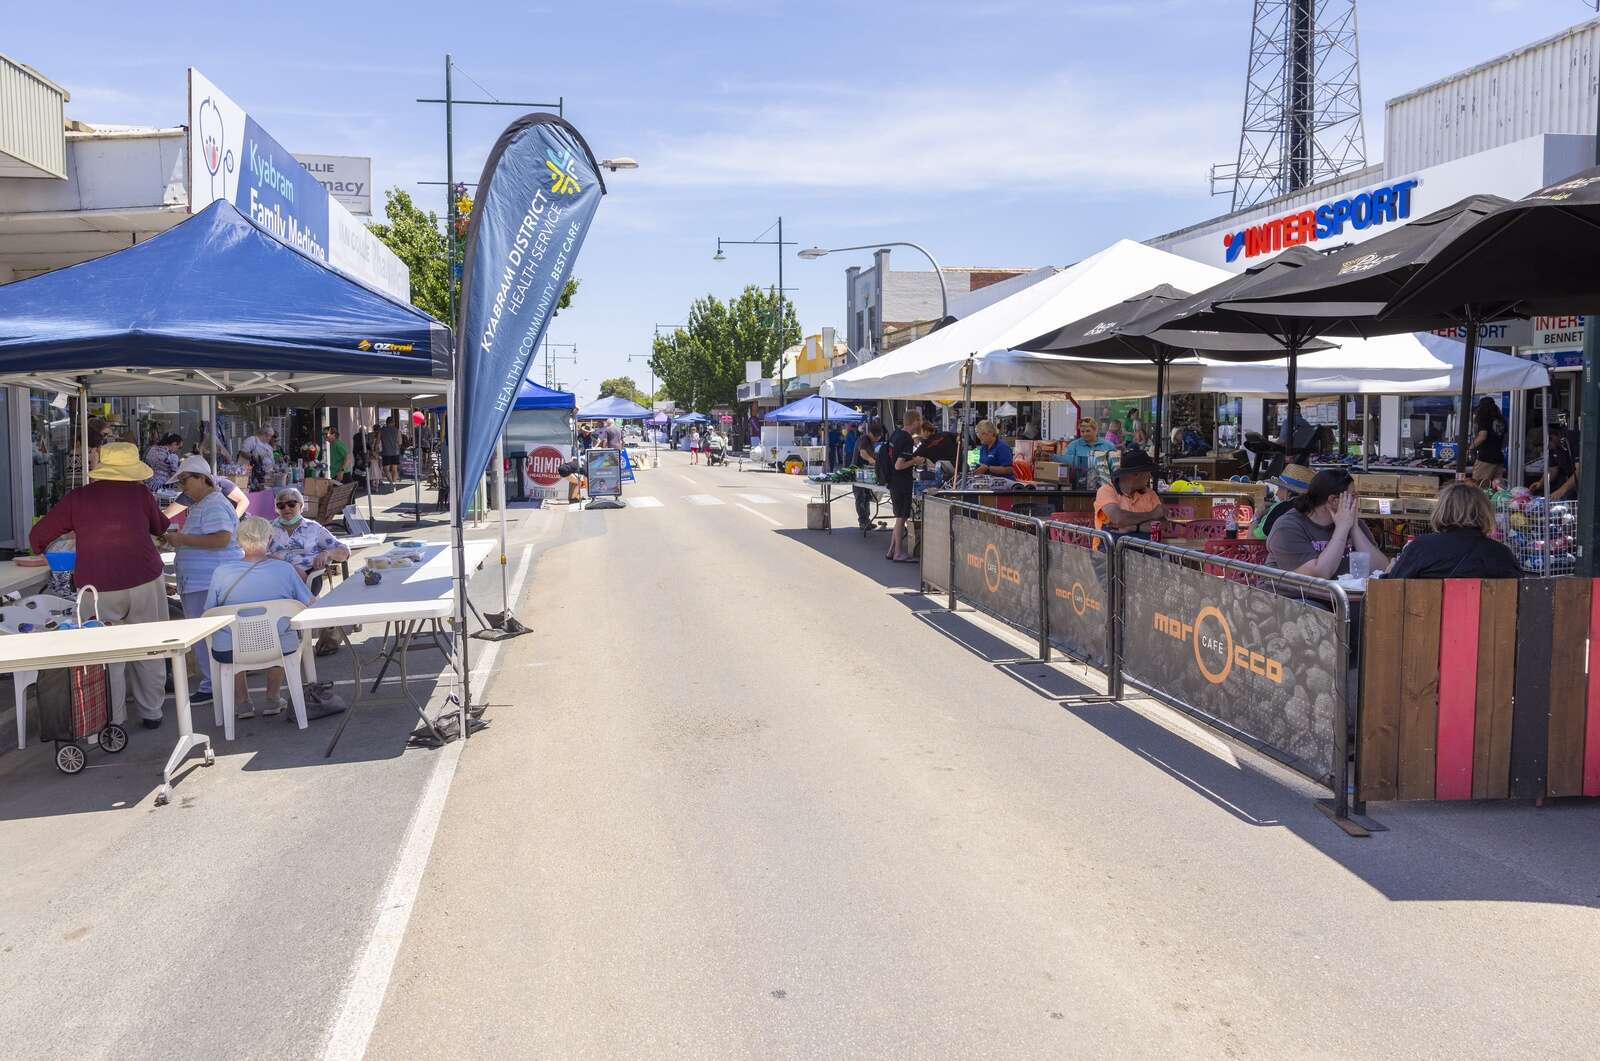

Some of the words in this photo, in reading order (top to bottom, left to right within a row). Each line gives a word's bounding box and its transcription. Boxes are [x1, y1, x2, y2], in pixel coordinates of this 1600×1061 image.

[250, 138, 294, 204] Kyabram
[250, 186, 287, 237] Family
[288, 214, 325, 260] Medicine
[1244, 179, 1418, 258] INTERSPORT
[480, 263, 516, 353] KYABRAM
[509, 188, 550, 267] DISTRICT
[508, 256, 538, 316] HEALTH
[531, 201, 563, 262] SERVICE
[494, 354, 523, 413] HEALTHY
[518, 282, 556, 359] COMMUNITY.
[550, 246, 574, 281] BEST
[563, 219, 582, 253] CARE.
[1152, 606, 1283, 684] morocco
